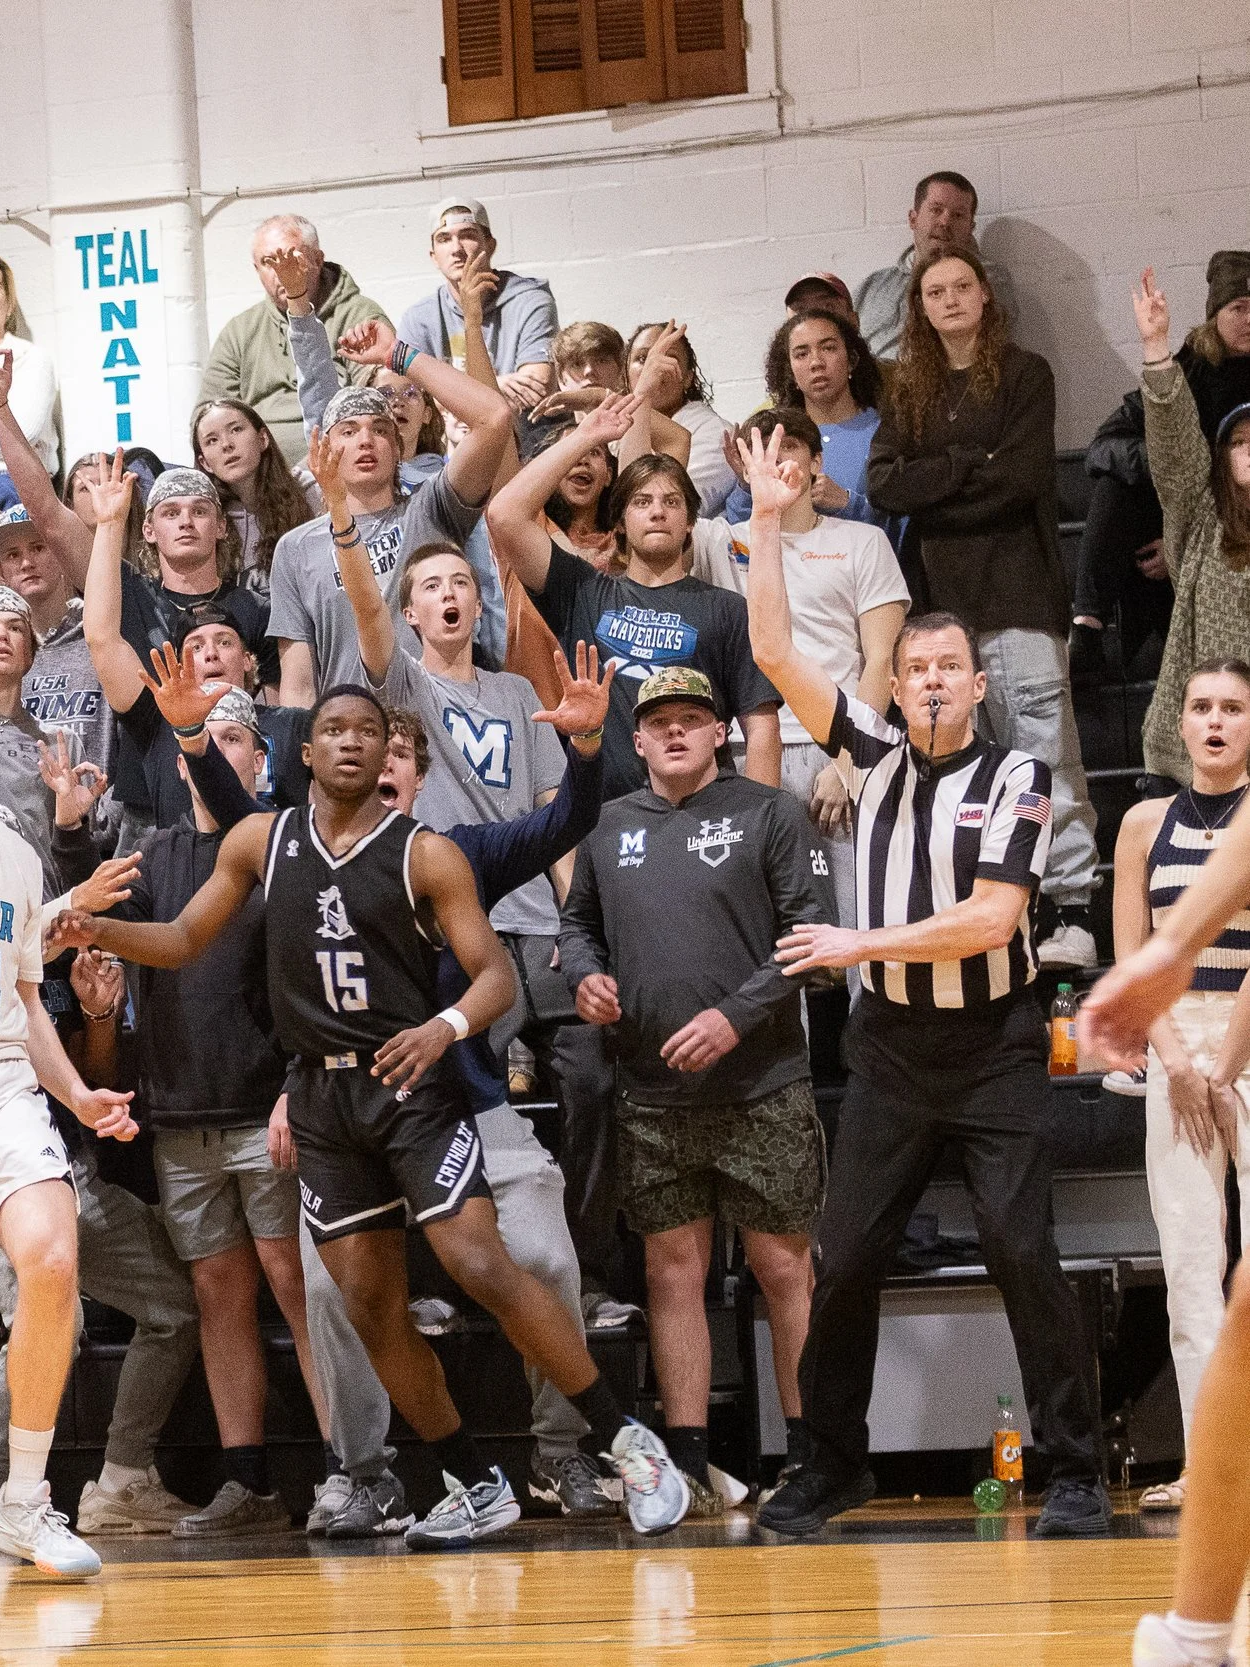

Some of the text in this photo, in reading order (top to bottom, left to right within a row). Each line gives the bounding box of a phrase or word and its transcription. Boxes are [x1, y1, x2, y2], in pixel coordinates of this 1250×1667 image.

[75, 229, 159, 289] TEAL
[100, 299, 141, 443] NATI
[622, 606, 681, 628] MILLER
[608, 618, 684, 651] MAVERICKS
[630, 646, 654, 660] 2023
[31, 674, 70, 692] USA
[20, 689, 102, 721] RIME
[442, 707, 513, 789] M
[619, 828, 647, 856] M
[810, 850, 829, 876] 26
[315, 951, 370, 1012] 15
